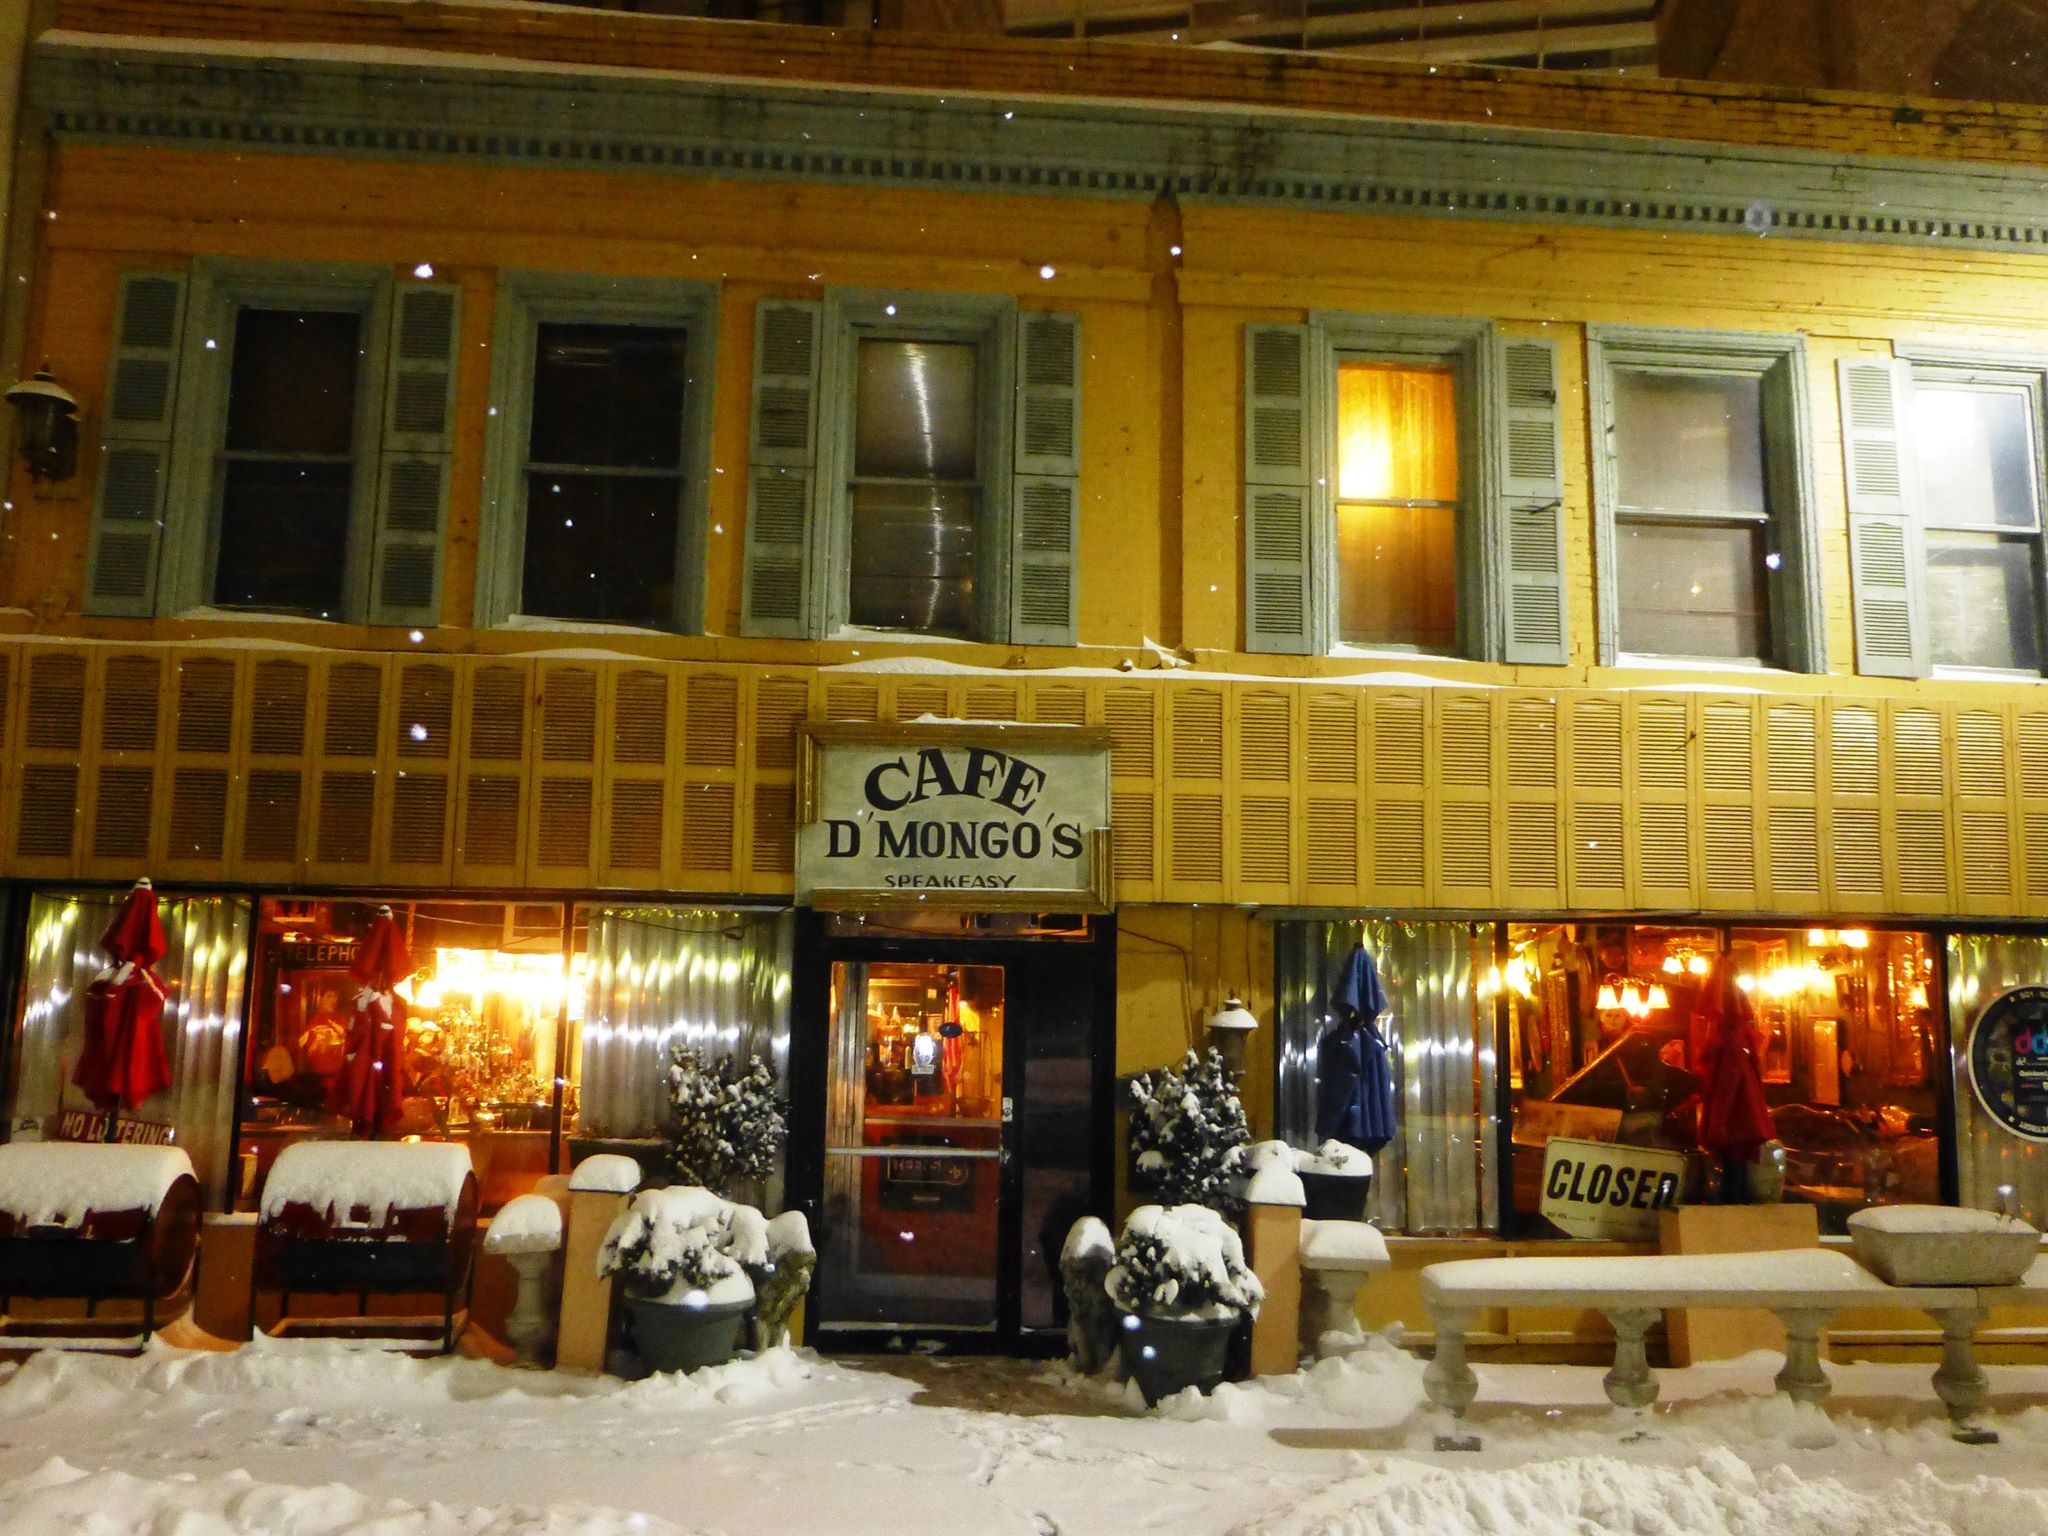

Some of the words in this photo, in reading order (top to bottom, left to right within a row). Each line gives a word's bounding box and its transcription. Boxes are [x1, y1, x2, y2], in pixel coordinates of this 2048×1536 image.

[864, 747, 1047, 816] CAFE
[823, 811, 1084, 860] D'MONGO'S
[884, 874, 1017, 889] SPEAKEASY
[61, 1111, 84, 1139] NO
[87, 1114, 172, 1145] LOTERING
[1546, 1158, 1679, 1211] CLOSED
